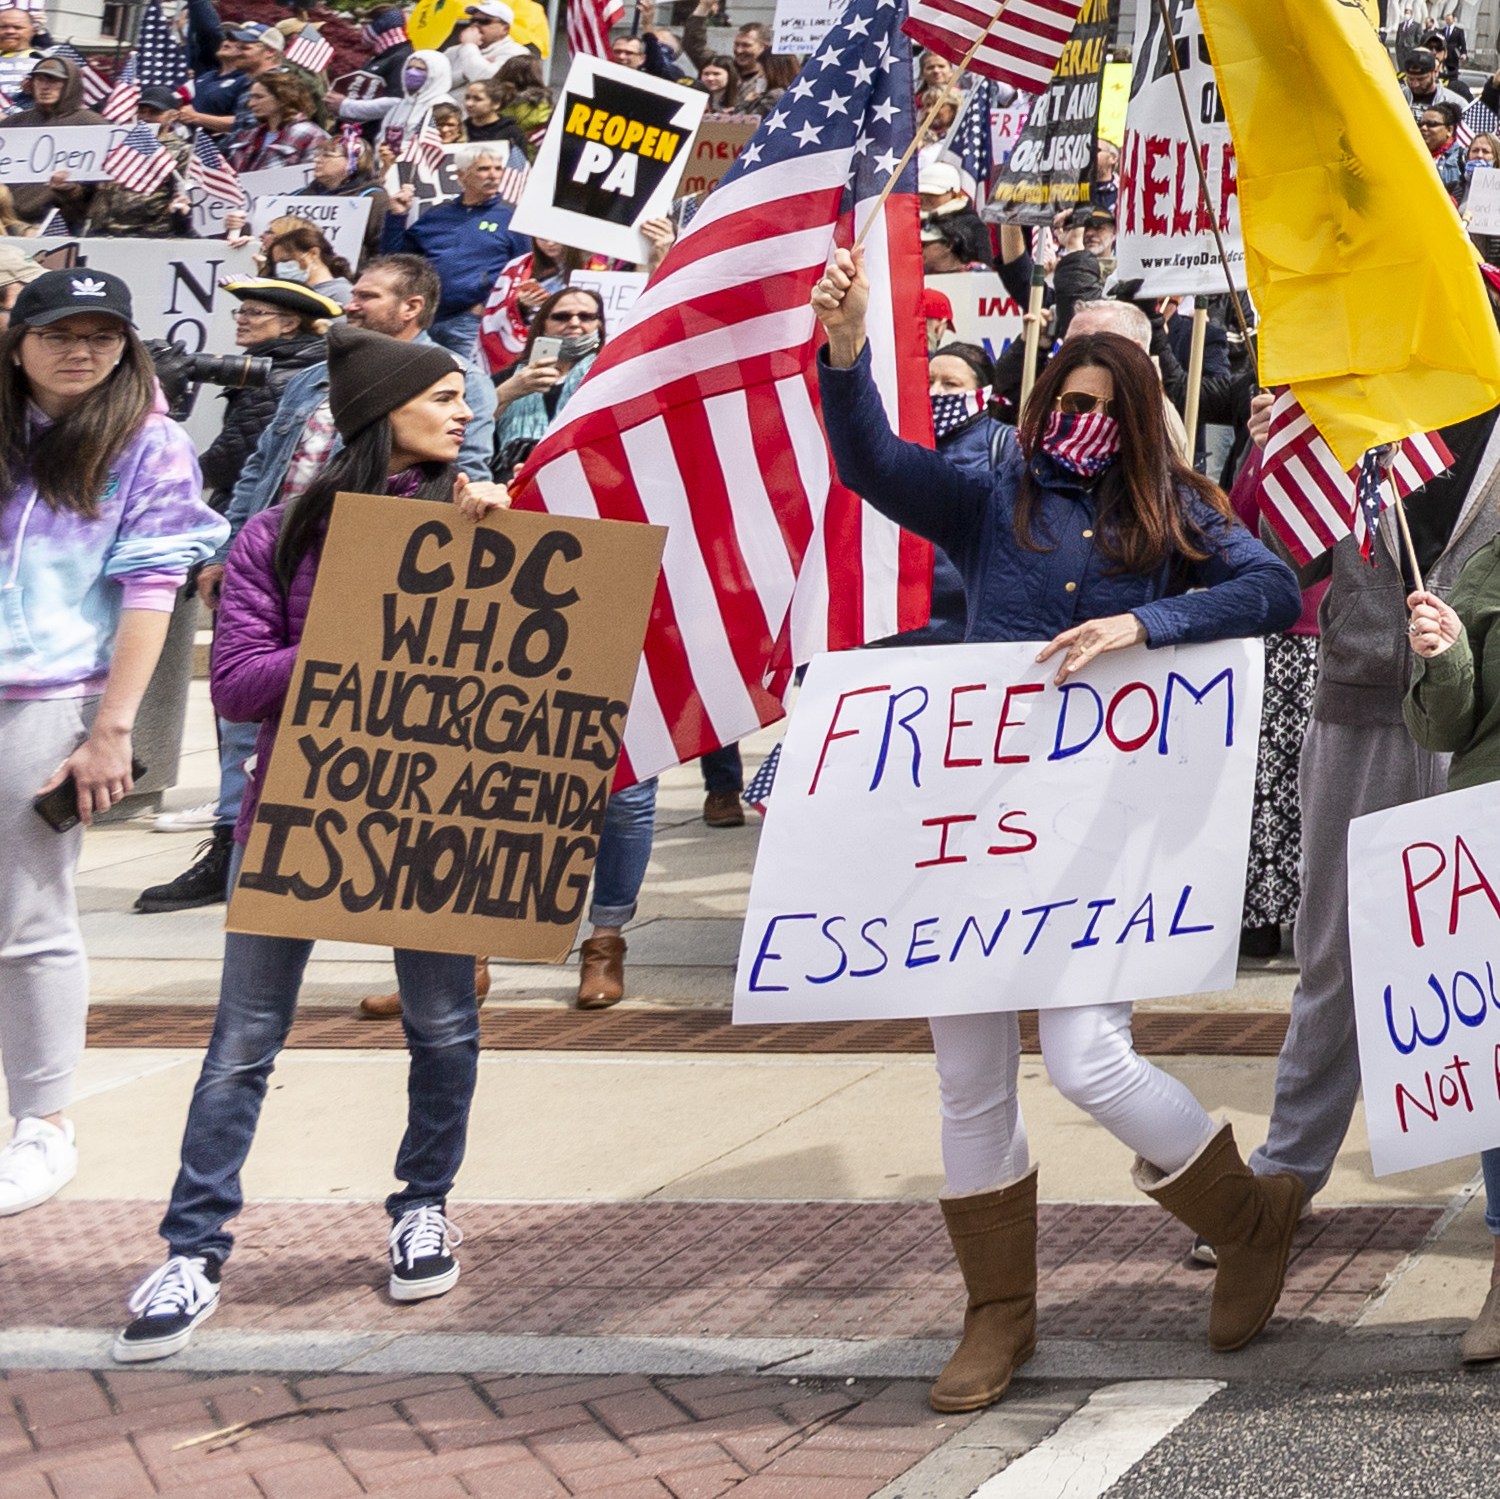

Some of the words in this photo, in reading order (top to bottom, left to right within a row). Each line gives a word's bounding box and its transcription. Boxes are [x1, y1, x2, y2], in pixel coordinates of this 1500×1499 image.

[565, 102, 681, 164] REOPEN
[572, 140, 640, 198] PA
[396, 519, 583, 610] CDC
[382, 592, 573, 682] W.H.O.
[808, 667, 1234, 796] FREEDOM
[297, 736, 438, 816] YOUR
[437, 761, 612, 835] AGENDA
[915, 810, 1038, 869] IS
[748, 884, 1215, 993] ESSENTIAL
